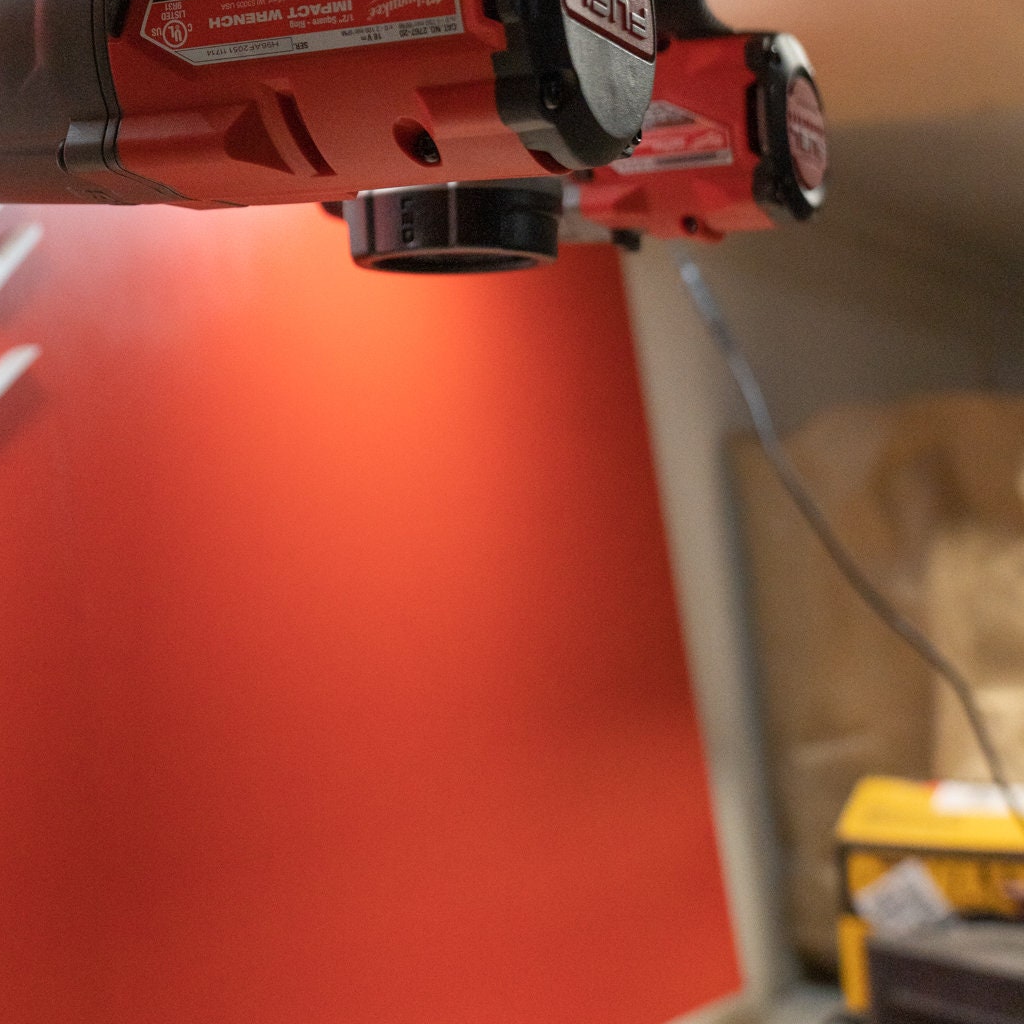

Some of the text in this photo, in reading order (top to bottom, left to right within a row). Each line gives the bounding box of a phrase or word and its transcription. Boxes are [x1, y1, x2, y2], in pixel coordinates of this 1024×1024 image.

[160, 9, 185, 20] LISTED
[207, 0, 352, 29] IMPACT WRENCH
[311, 14, 336, 26] Square
[289, 18, 305, 29] Ring
[150, 26, 161, 36] US
